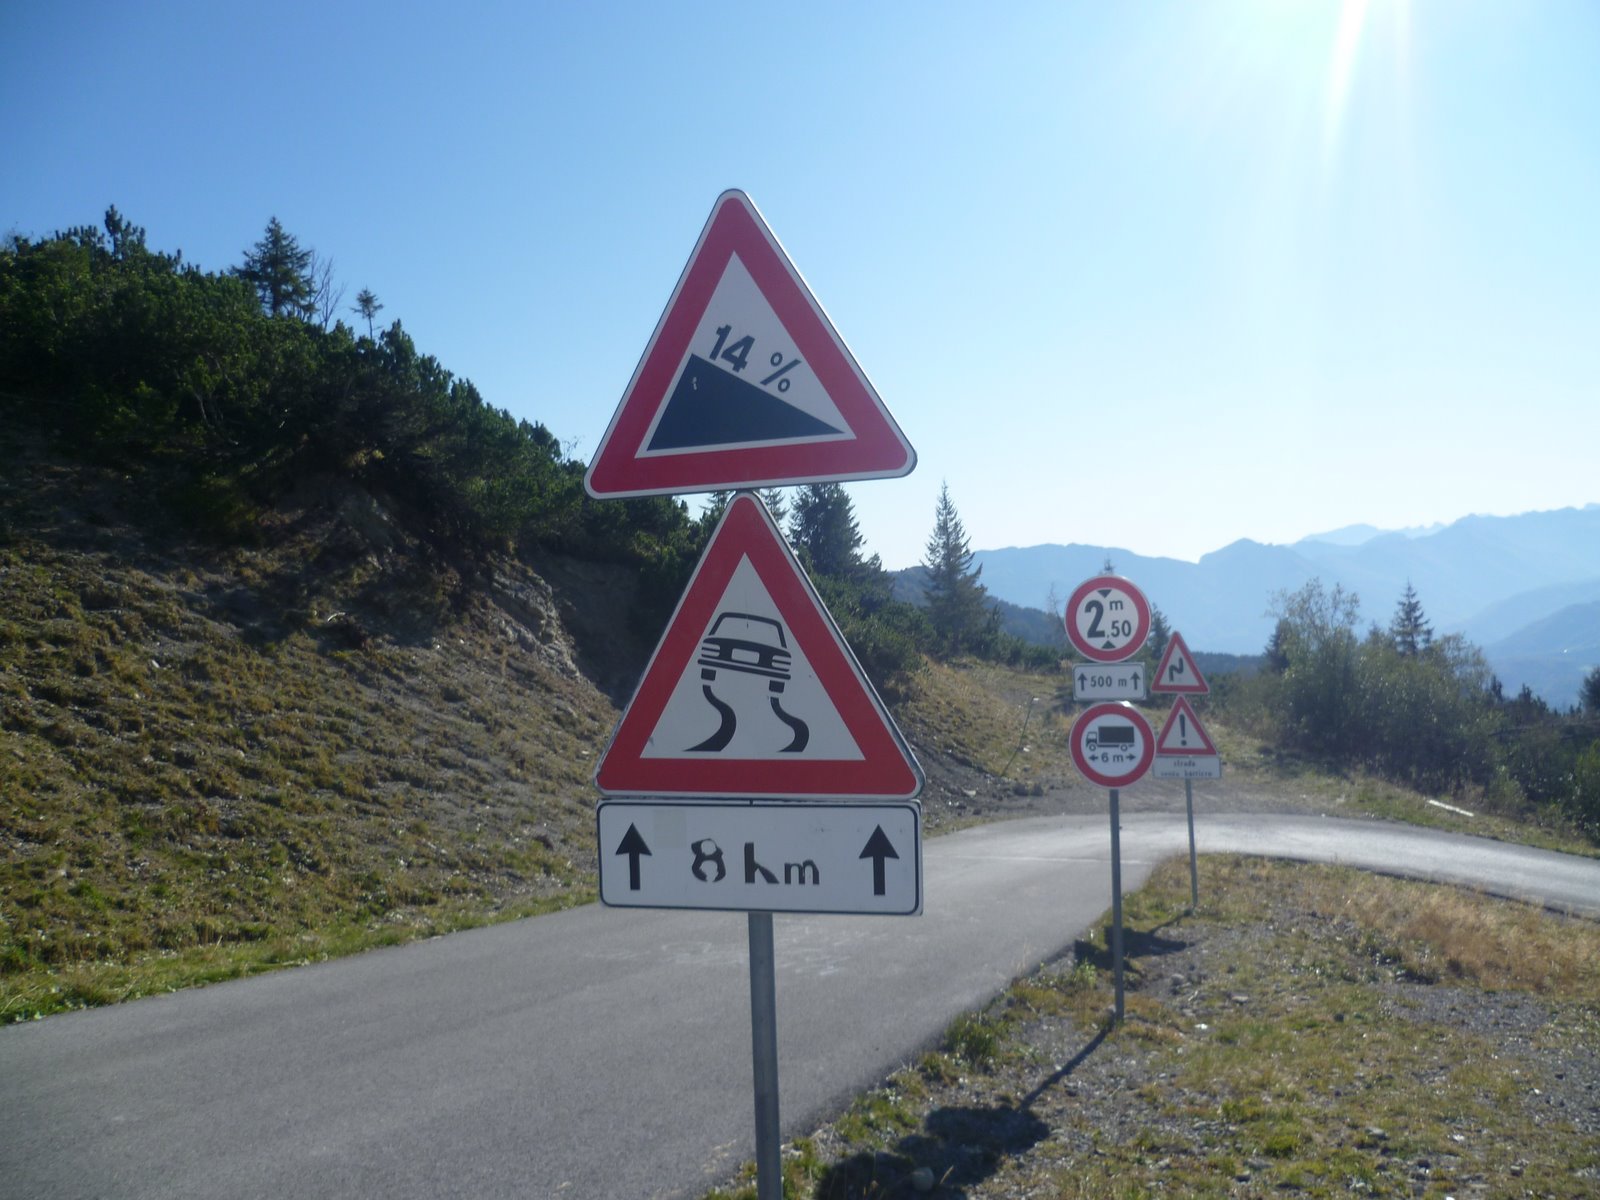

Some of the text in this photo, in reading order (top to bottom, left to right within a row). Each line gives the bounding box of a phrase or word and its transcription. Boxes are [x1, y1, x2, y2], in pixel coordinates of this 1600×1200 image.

[709, 324, 802, 393] 14 %
[1109, 601, 1123, 611] m
[1090, 675, 1127, 688] 500 m
[1101, 752, 1124, 763] 6 m
[691, 838, 820, 885] 8 km
